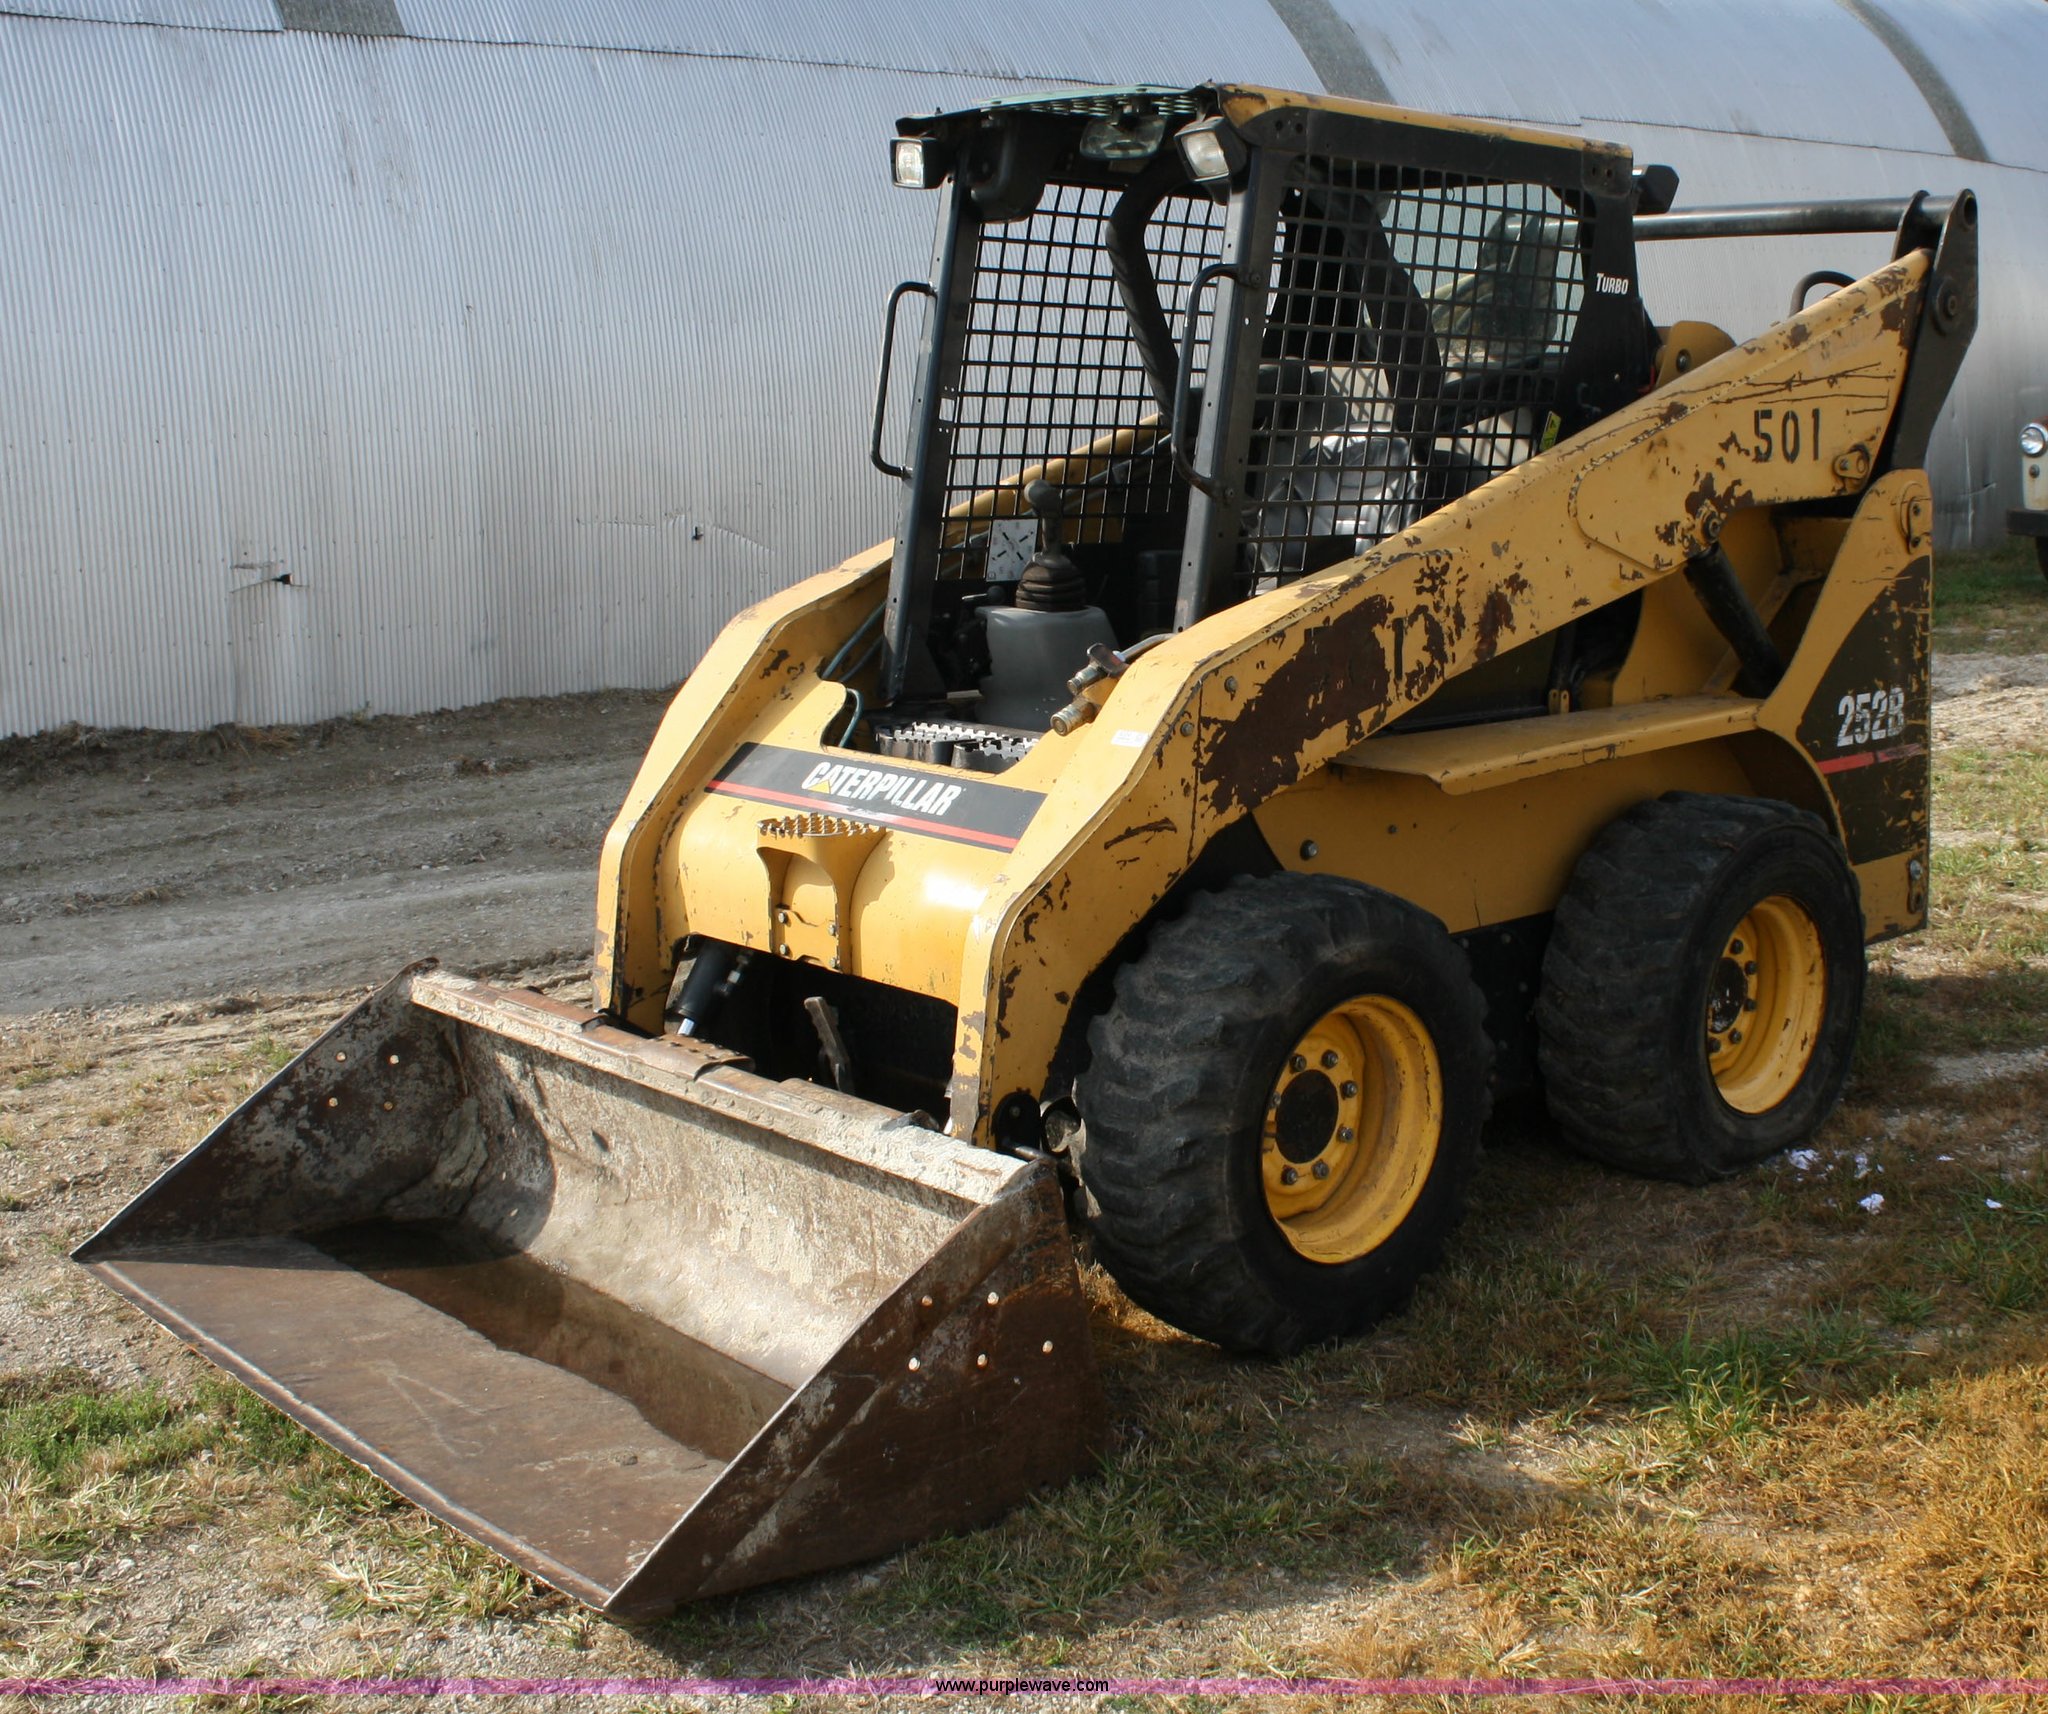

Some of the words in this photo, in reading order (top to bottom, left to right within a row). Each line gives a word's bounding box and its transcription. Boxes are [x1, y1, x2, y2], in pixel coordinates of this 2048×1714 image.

[1754, 408, 1820, 463] 501
[1837, 687, 1905, 747] 252B
[802, 761, 961, 816] CATERPILLAR
